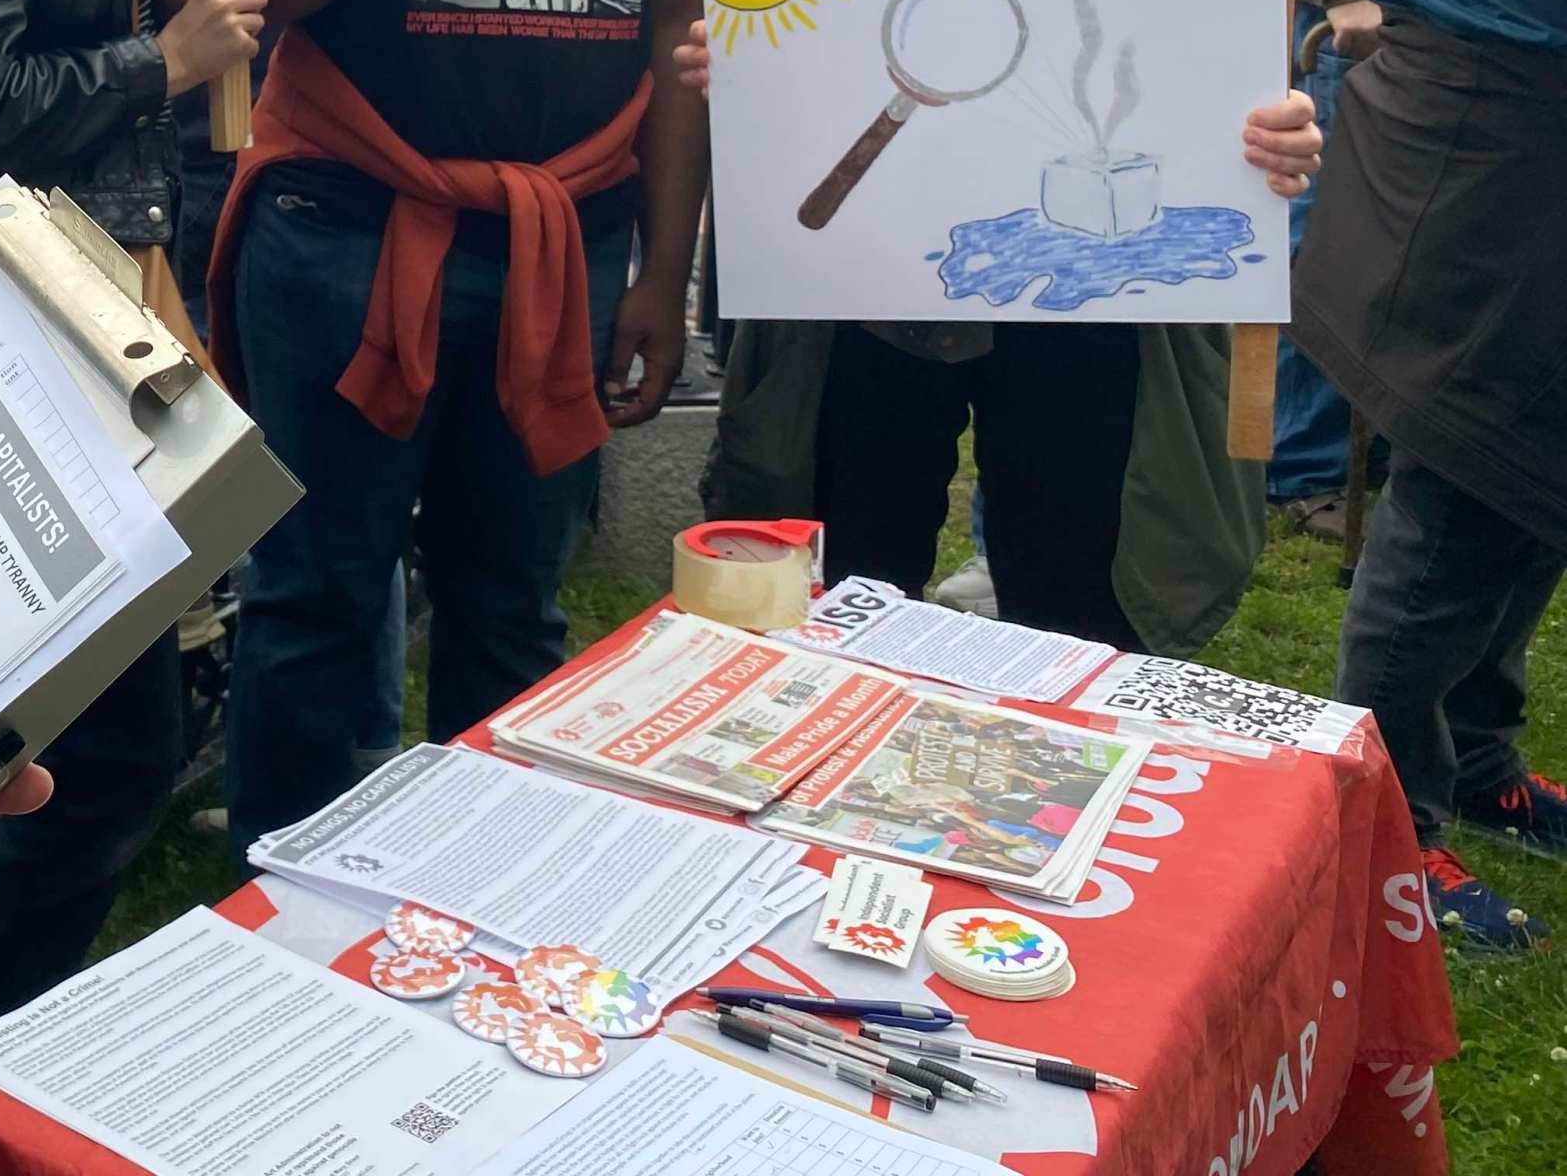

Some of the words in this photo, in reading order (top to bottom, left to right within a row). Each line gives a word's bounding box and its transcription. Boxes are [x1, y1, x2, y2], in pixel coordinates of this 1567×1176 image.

[0, 553, 45, 620] TYRANNY
[811, 592, 887, 630] ISG
[607, 682, 729, 761] SOCIALISM
[718, 648, 772, 687] TODAY
[766, 733, 806, 765] Make
[801, 711, 837, 746] Pride
[838, 706, 849, 718] a
[846, 676, 882, 710] Month
[291, 834, 314, 850] NO
[313, 811, 354, 841] KINGS,
[346, 798, 367, 816] NO
[363, 753, 432, 801] CAPITALISTS!
[794, 782, 810, 804] of
[858, 870, 882, 921] Independent
[894, 906, 914, 931] Group
[40, 996, 63, 1015] Not
